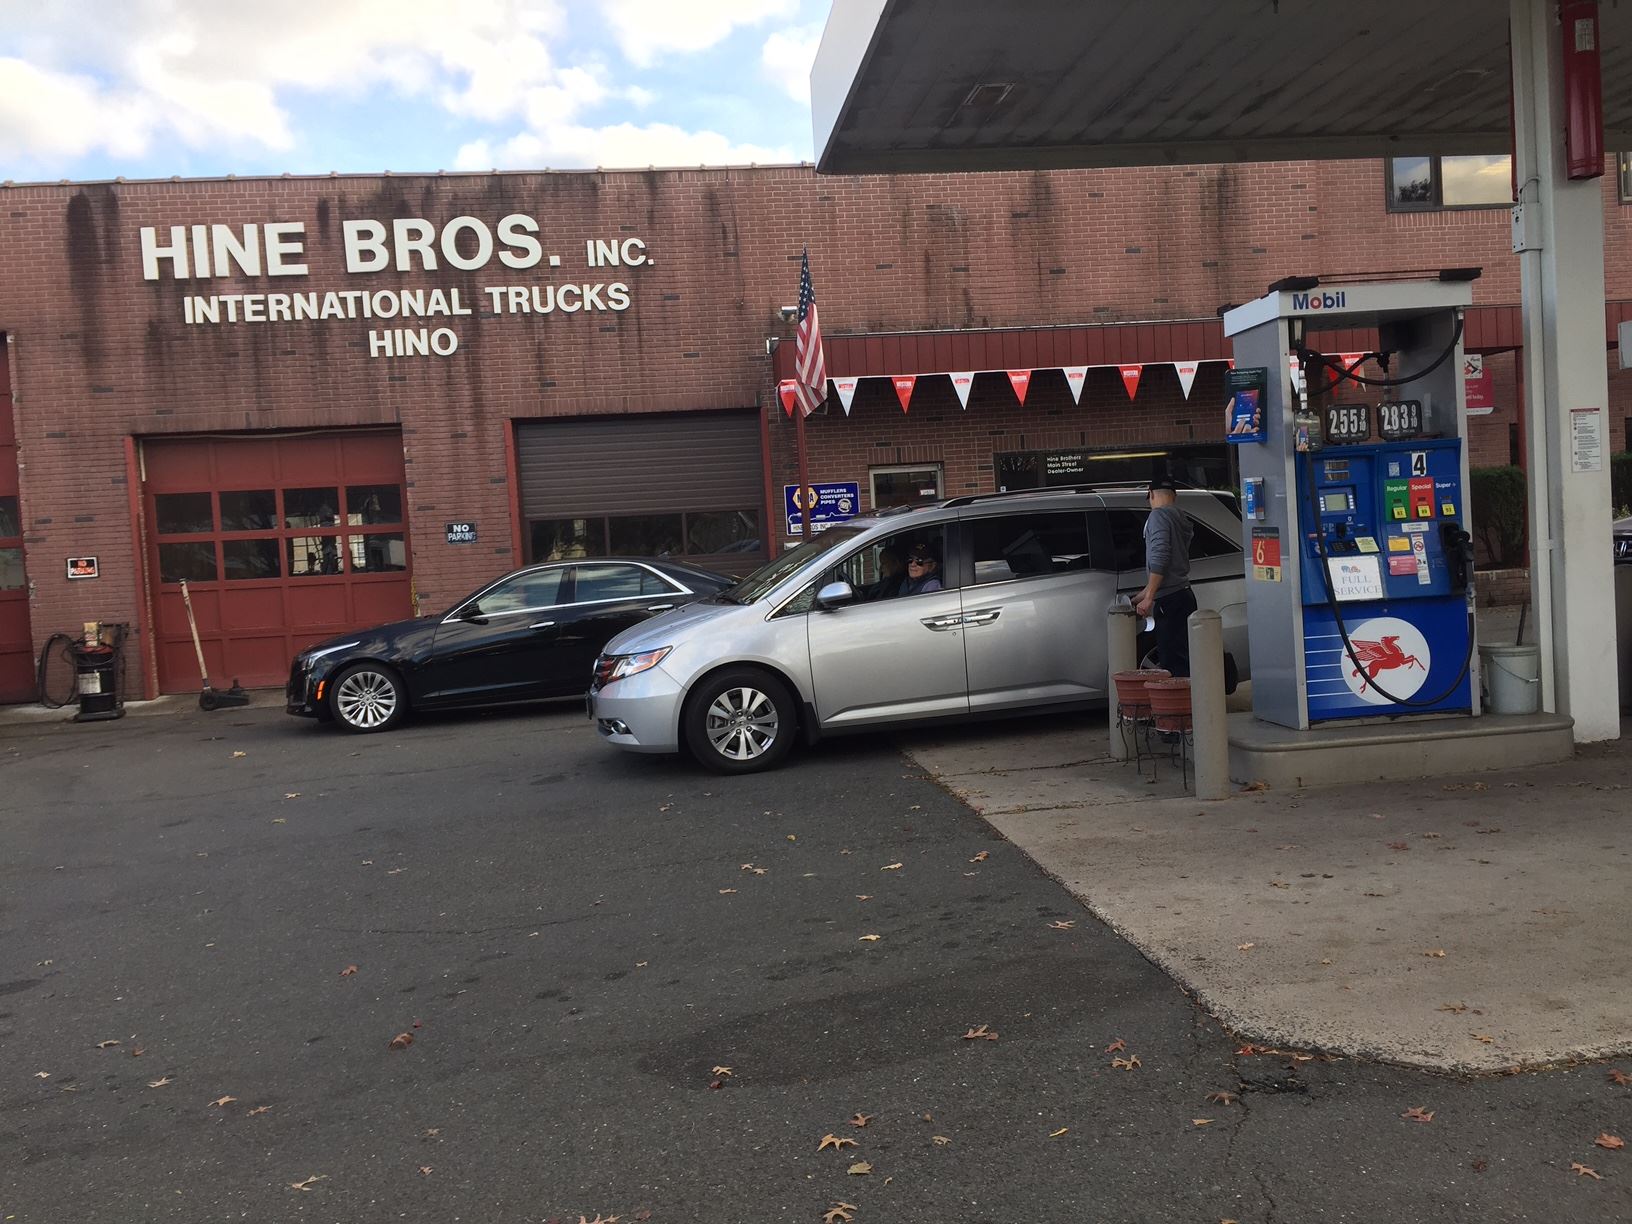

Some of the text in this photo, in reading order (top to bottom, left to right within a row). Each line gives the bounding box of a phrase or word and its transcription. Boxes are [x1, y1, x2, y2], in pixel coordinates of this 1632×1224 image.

[140, 213, 655, 281] HINE BROS. INC.
[183, 282, 631, 324] INTERNATIONAL TRUCKS
[1292, 291, 1346, 311] Mobil
[369, 327, 459, 358] HINO
[1330, 409, 1358, 434] 2.55
[1381, 404, 1409, 431] 2.83
[1413, 454, 1426, 475] 4
[1411, 483, 1432, 491] Special
[448, 532, 476, 541] PARKING
[453, 524, 470, 532] NO
[1334, 584, 1382, 595] SERVICE
[1342, 575, 1372, 584] FULL
